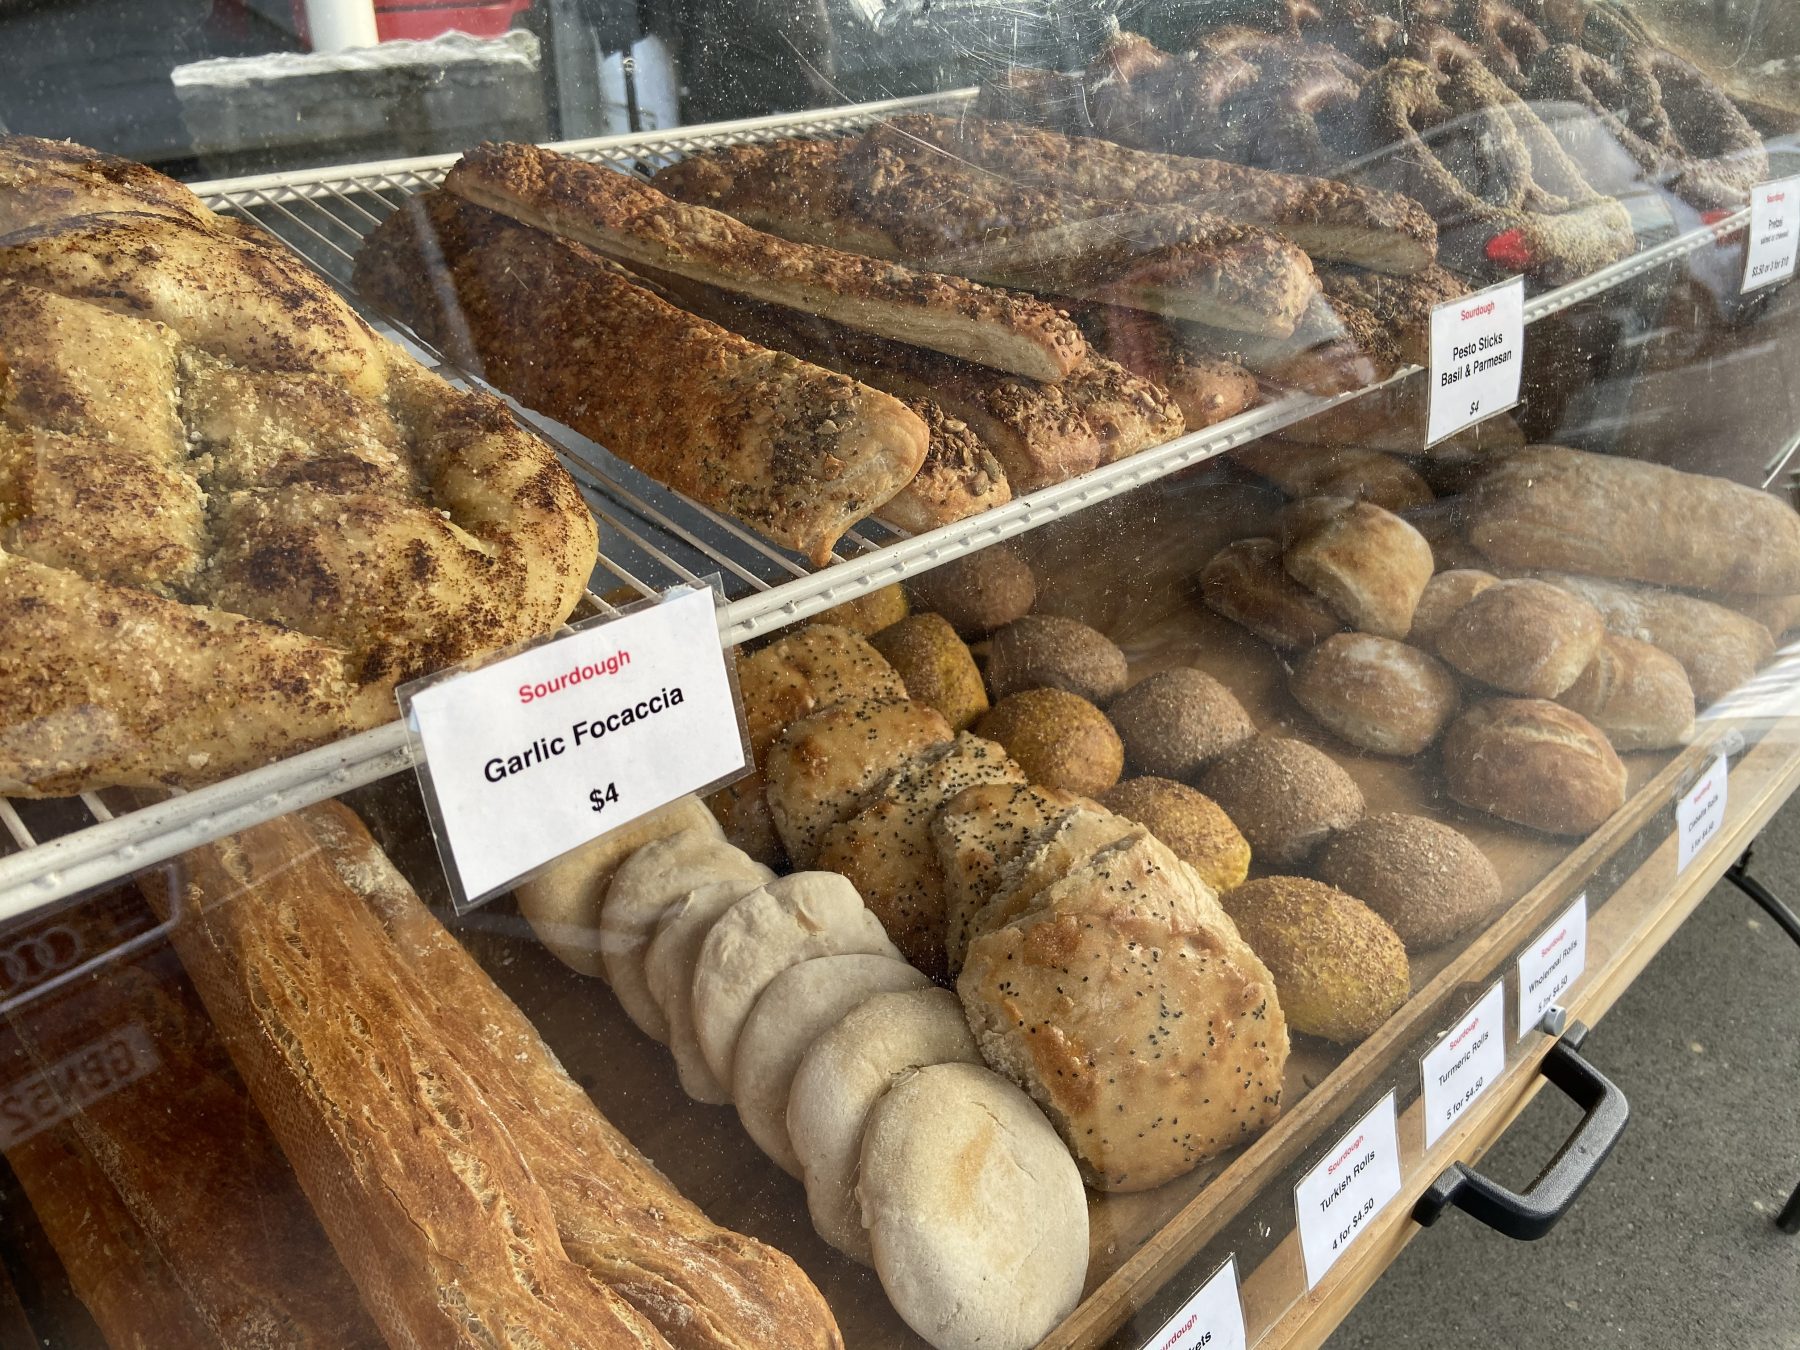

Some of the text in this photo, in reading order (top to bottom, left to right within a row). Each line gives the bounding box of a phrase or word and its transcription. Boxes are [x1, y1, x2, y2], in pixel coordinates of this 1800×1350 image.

[1461, 301, 1495, 321] Sourdough
[1453, 332, 1503, 361] Pesto Sticks
[1441, 349, 1512, 387] Basil & Parmesan
[1469, 400, 1480, 415] $4
[519, 650, 631, 704] Sourdough
[484, 687, 685, 783] Garlic Focaccia
[589, 782, 619, 813] $4
[1541, 928, 1567, 957] Sourdough
[1528, 939, 1578, 994] Wholemeal Rolls
[1552, 975, 1568, 998] $4.50
[1449, 1017, 1480, 1051] Sourdough
[1438, 1030, 1489, 1087] Turmeric Rolls
[1446, 1076, 1483, 1121] 5 for $4.50
[1327, 1135, 1364, 1175] Sourdough
[1319, 1150, 1376, 1213] Turkish Rolls
[1332, 1197, 1375, 1251] 4 for $4.50
[1160, 1314, 1198, 1350] urdough
